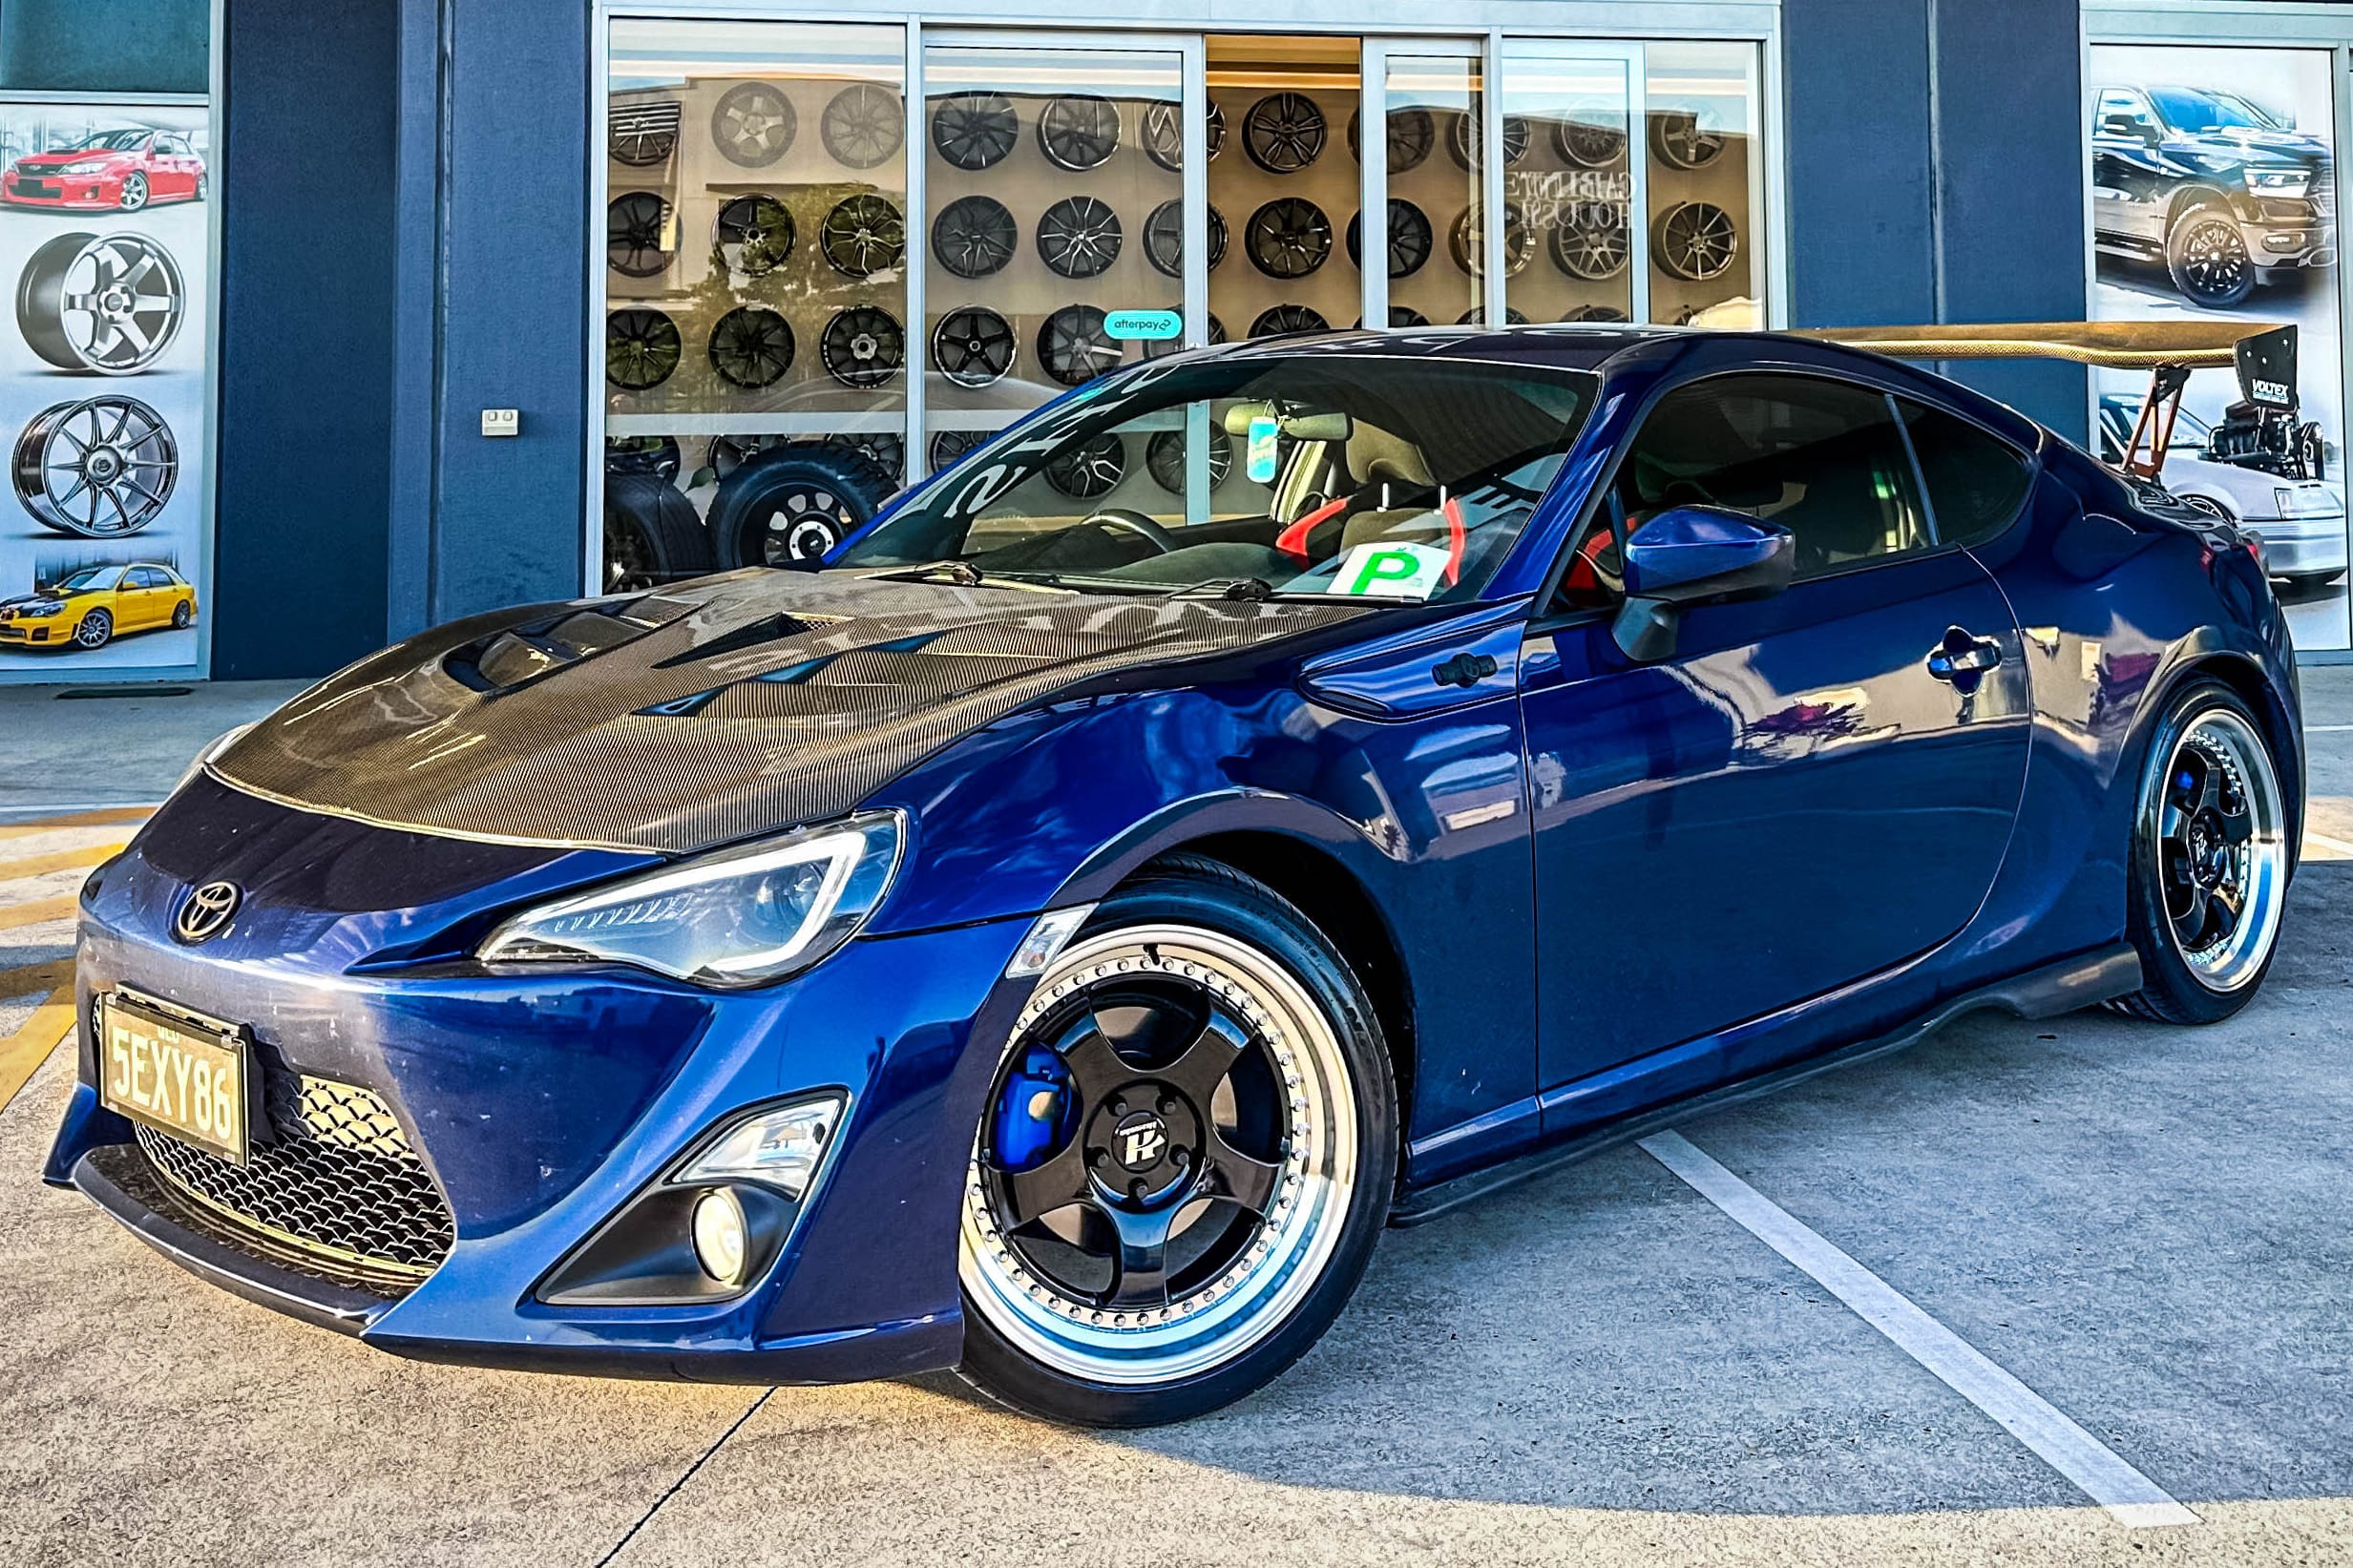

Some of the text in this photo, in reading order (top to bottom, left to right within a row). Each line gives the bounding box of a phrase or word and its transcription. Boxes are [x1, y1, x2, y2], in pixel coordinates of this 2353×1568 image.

[1114, 319, 1159, 331] afterpay
[2252, 378, 2289, 398] VOLTEX
[1350, 552, 1420, 596] P
